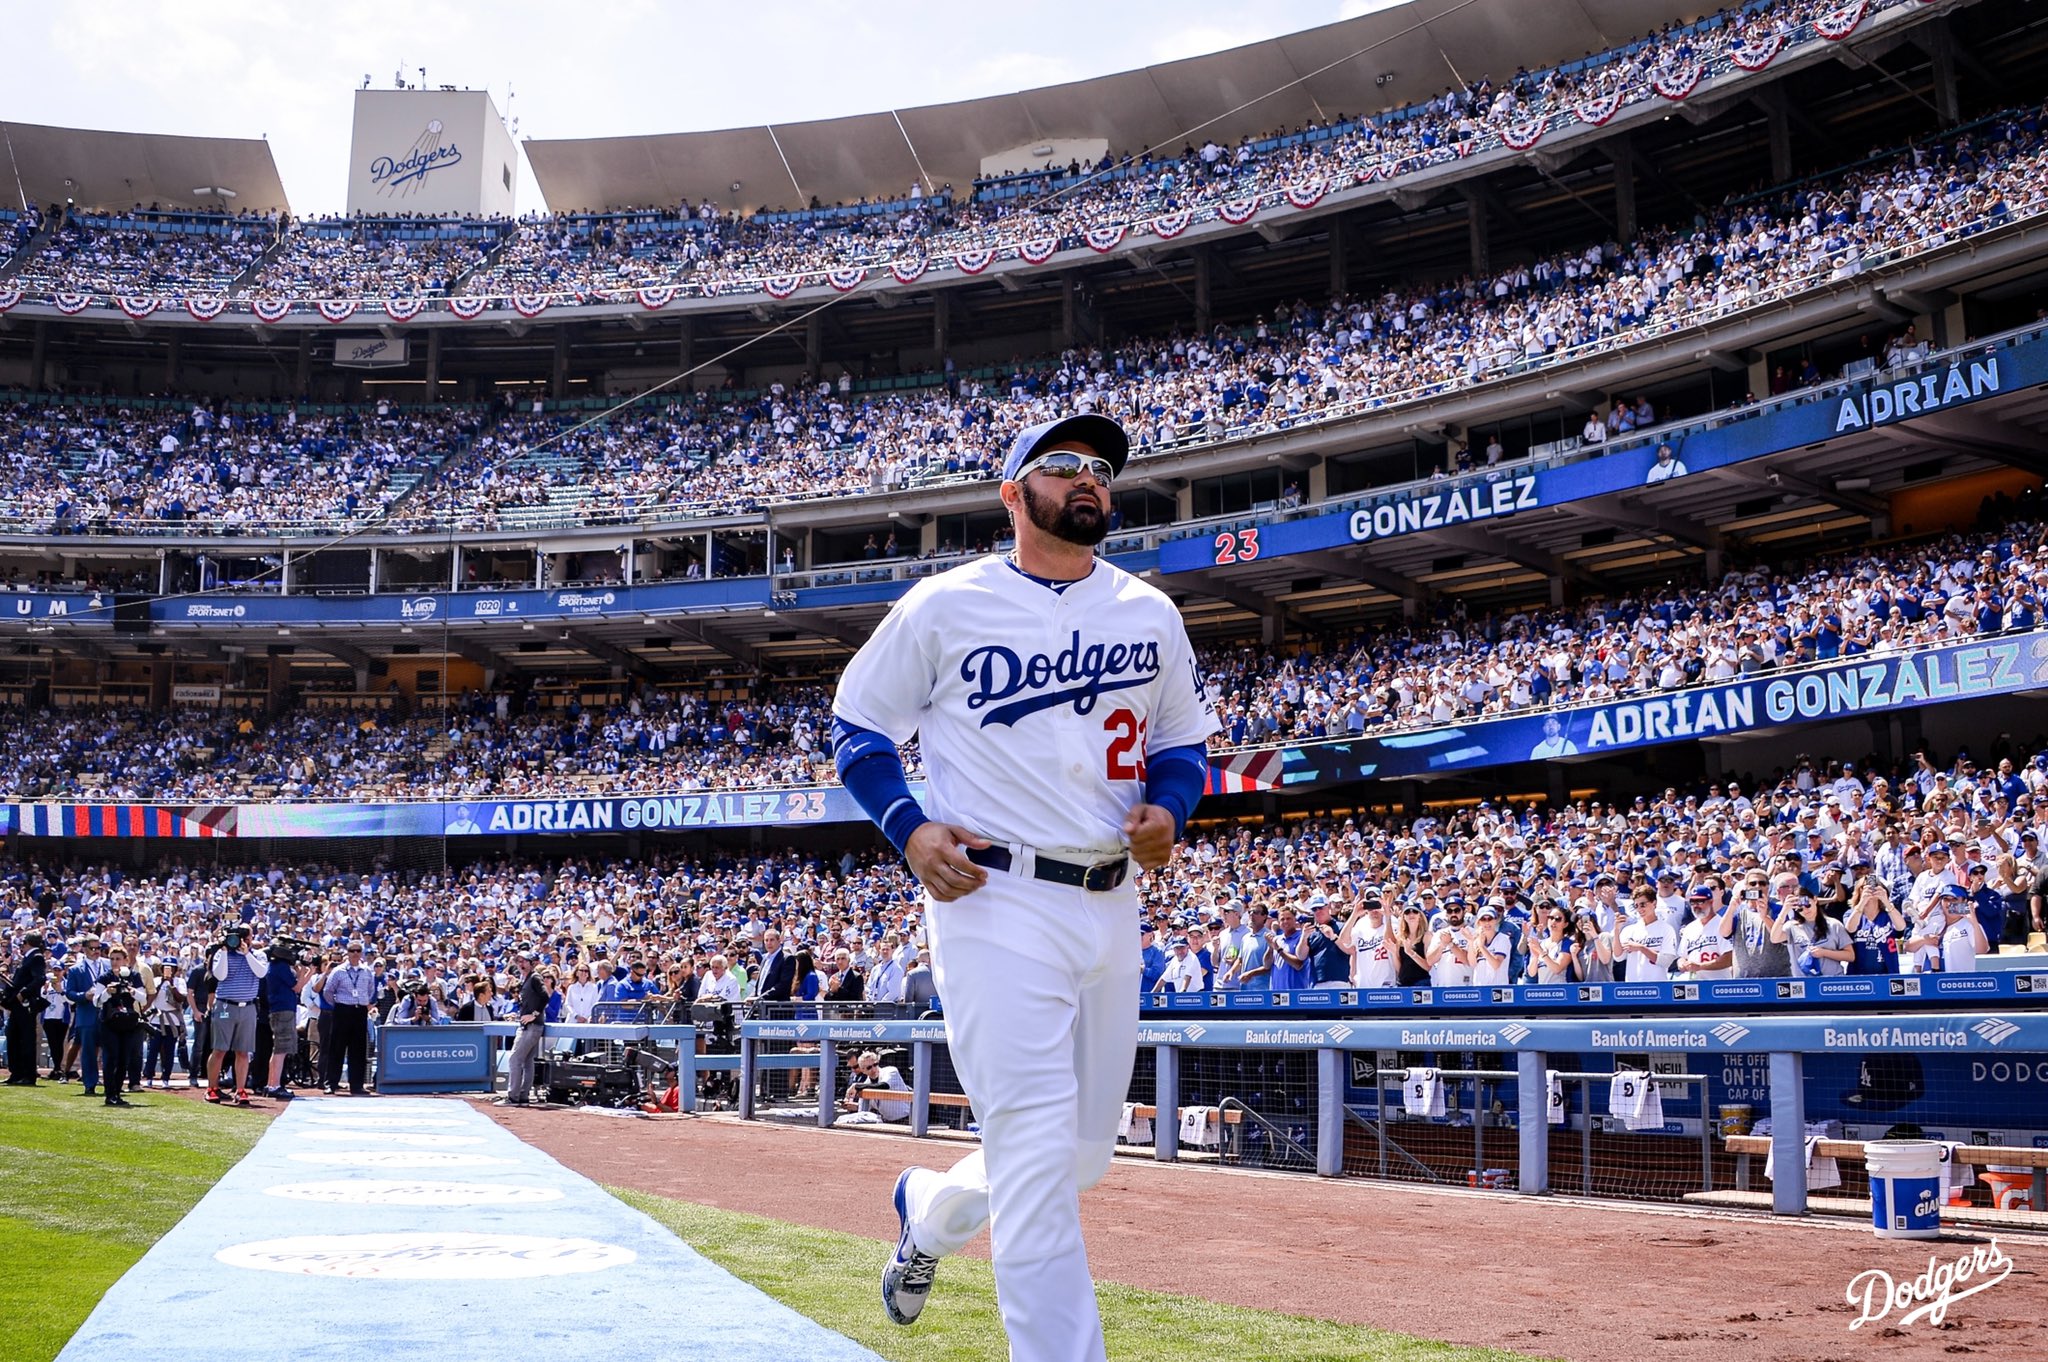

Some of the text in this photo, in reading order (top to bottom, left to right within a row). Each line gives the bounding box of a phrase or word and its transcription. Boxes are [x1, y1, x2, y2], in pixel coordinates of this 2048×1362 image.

[371, 143, 462, 185] Dodgers
[1350, 475, 1538, 541] GONZÁLEZ
[1215, 528, 1259, 565] 23
[477, 601, 499, 610] 1020
[960, 630, 1160, 730] Dodgers
[1766, 642, 2024, 723] GONZÁLEZ
[620, 793, 781, 828] GONZÁLEZ
[786, 791, 827, 821] 23
[1715, 987, 1760, 995] DODGERS.COM
[1822, 984, 1871, 992] DODGERS.COM
[1941, 981, 1994, 989] DODGERS.COM
[934, 1027, 947, 1038] Ame
[1148, 1029, 1182, 1043] America
[1246, 1029, 1324, 1044] Bank of America
[1401, 1030, 1496, 1046] Bank of America
[1591, 1029, 1707, 1047] Bank of America
[1824, 1027, 1967, 1047] Bank of America
[400, 1050, 474, 1059] DODGERS.COM
[1723, 1055, 1770, 1067] THE OFFI
[1723, 1068, 1770, 1087] ON-FI
[1728, 1088, 1765, 1101] CAP OF
